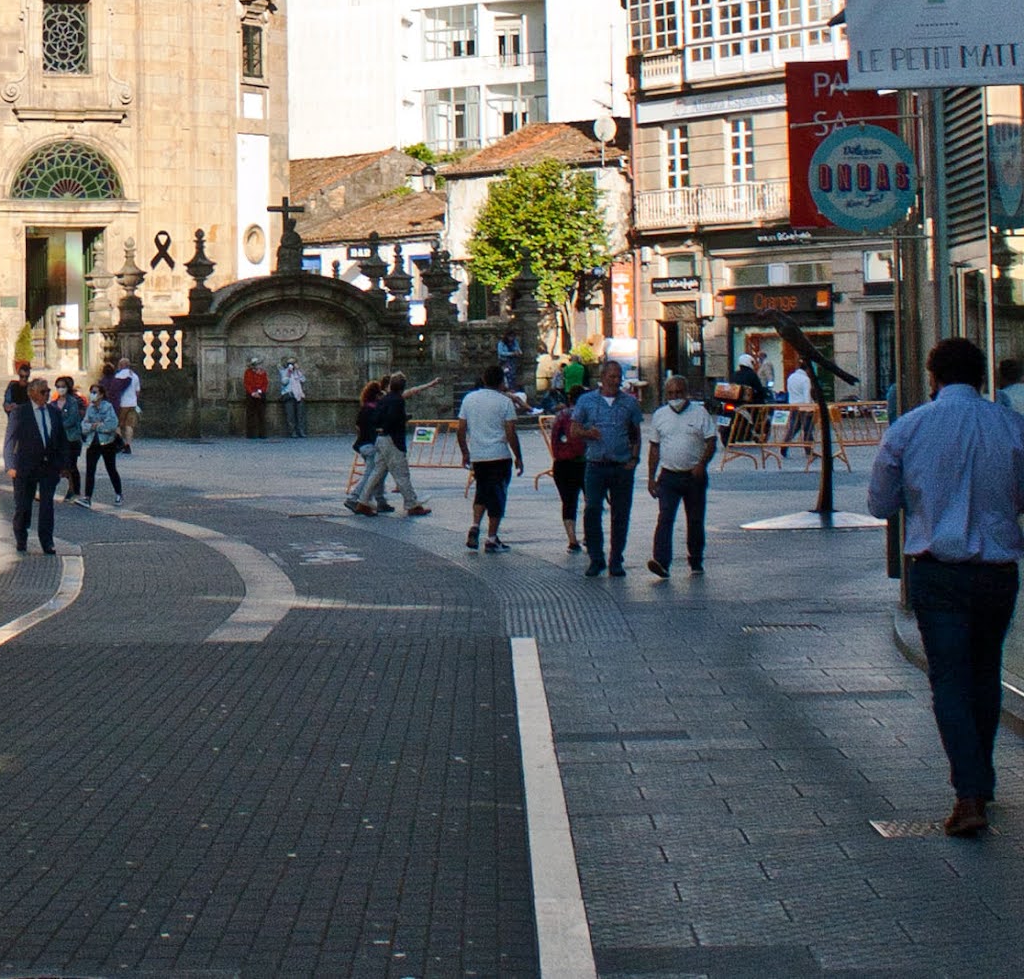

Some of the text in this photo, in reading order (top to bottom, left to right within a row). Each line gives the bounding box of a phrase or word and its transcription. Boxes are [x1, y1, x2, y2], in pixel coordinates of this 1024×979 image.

[856, 49, 884, 73] LE
[818, 161, 911, 191] ONDAS
[350, 248, 371, 258] BAR
[753, 292, 798, 312] Orange
